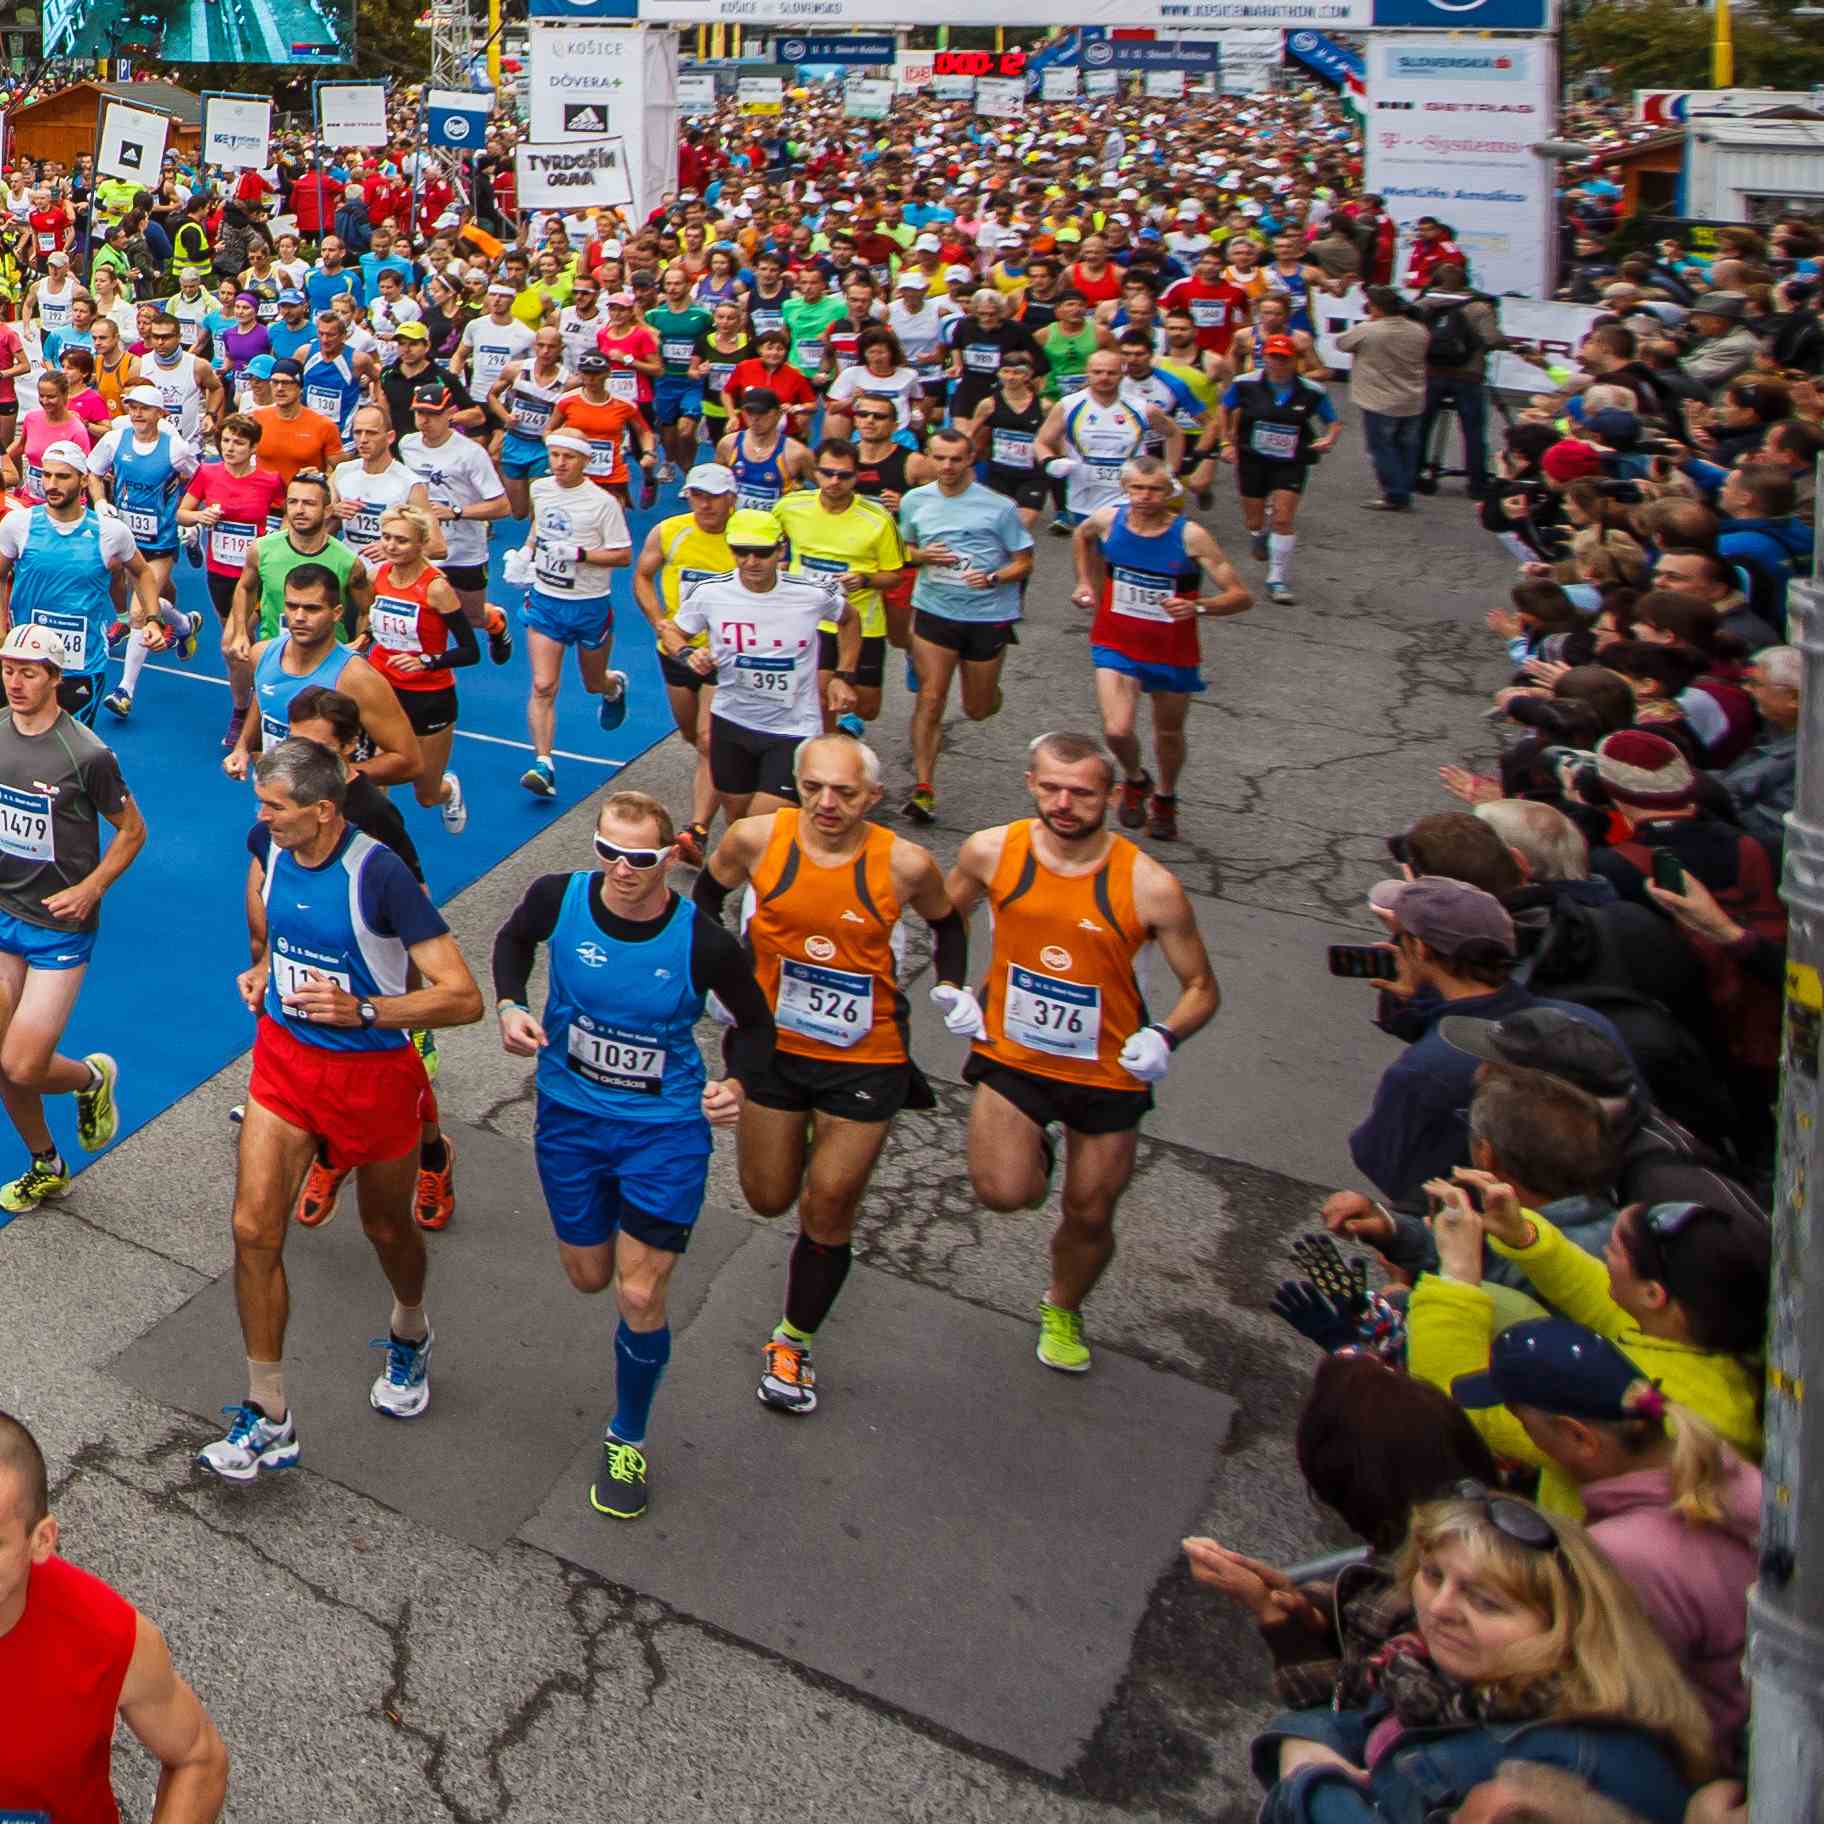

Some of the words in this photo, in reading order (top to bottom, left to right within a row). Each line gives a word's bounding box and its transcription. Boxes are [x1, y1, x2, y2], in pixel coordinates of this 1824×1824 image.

[567, 40, 624, 56] KOŠICE
[130, 514, 150, 531] 133
[355, 514, 380, 533] 125
[382, 615, 408, 638] F13
[753, 672, 789, 694] 395
[0, 808, 47, 840] 1479
[807, 982, 860, 1024] 526
[1033, 998, 1085, 1034] 376
[591, 1040, 657, 1073] 1037
[598, 1073, 647, 1091] adidas
